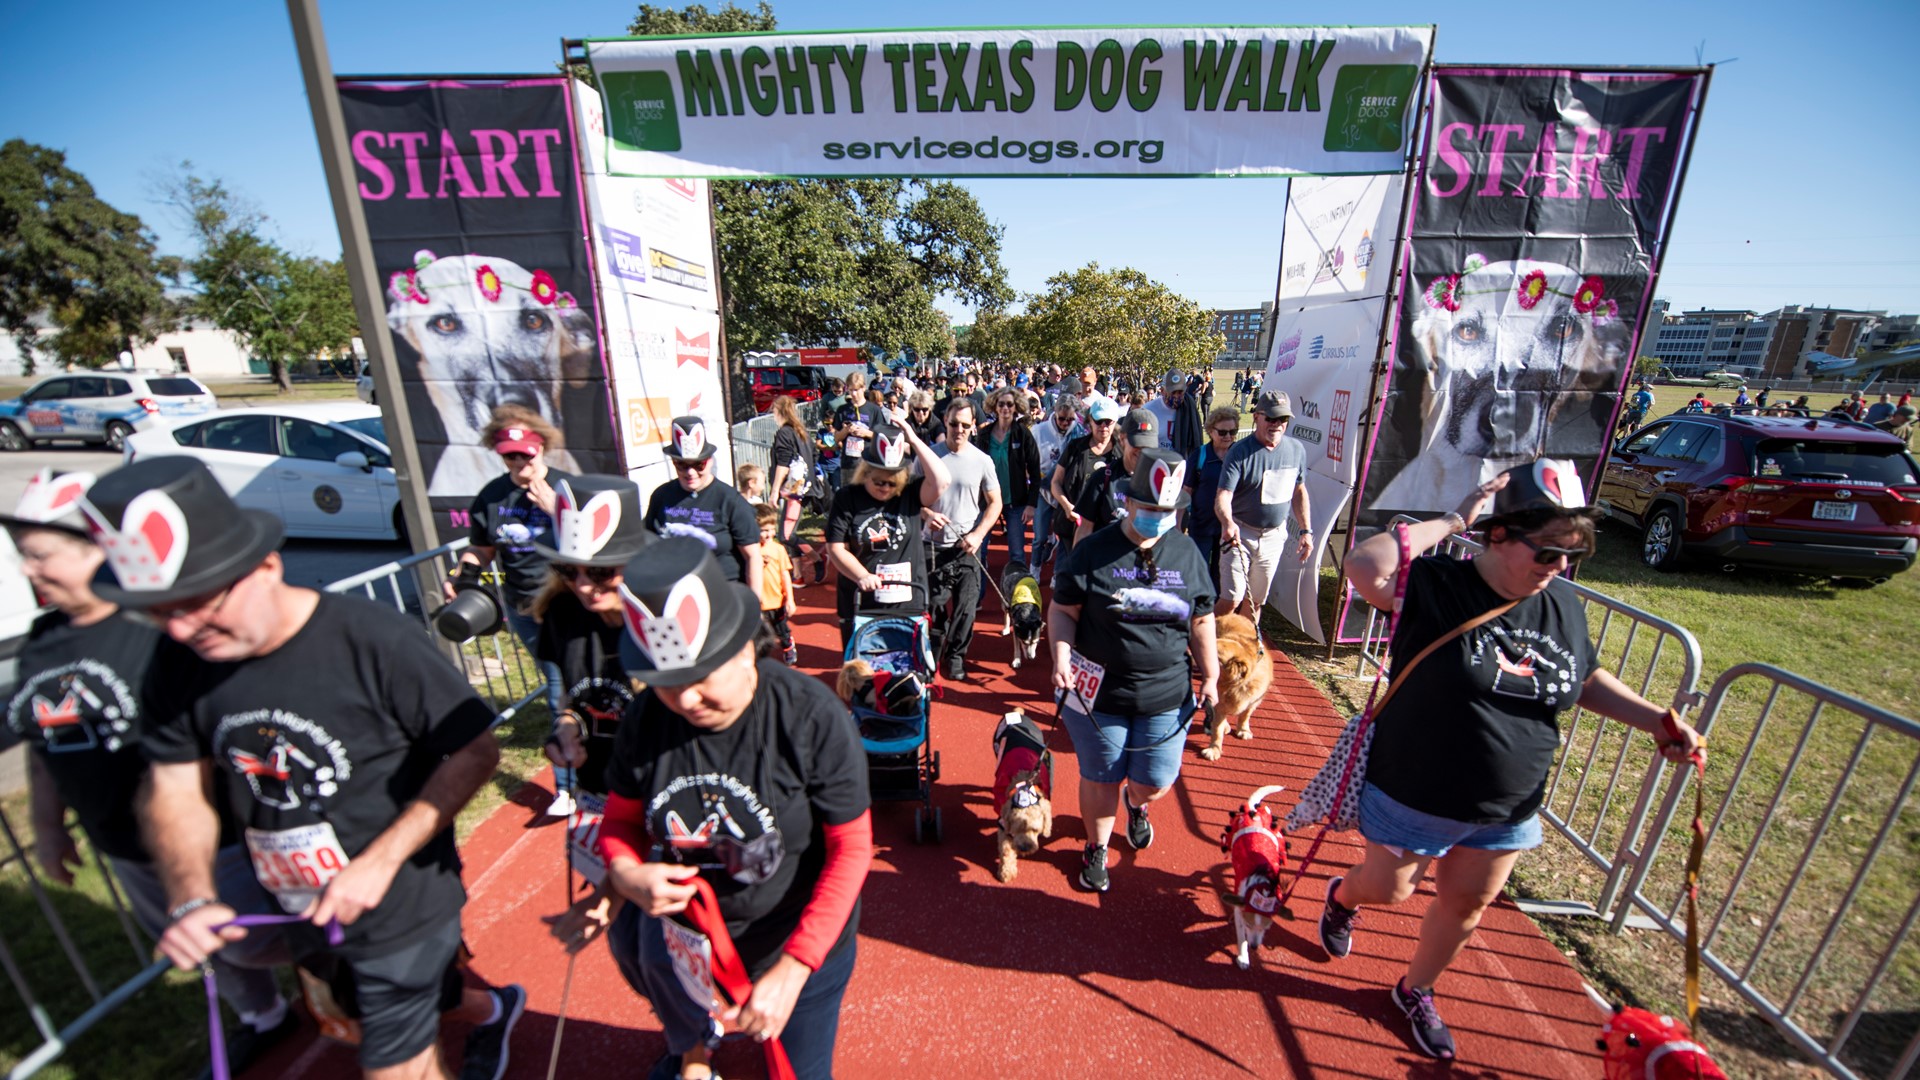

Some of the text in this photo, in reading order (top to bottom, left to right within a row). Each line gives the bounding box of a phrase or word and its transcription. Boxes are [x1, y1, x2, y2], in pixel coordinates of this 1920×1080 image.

[676, 38, 1336, 117] MIGHTY TEXAS DOG WALK
[633, 99, 666, 110] SERVICE
[1360, 96, 1398, 107] SERVICE
[634, 109, 663, 121] DOGS
[1357, 106, 1390, 118] DOGS
[823, 136, 1164, 163] servicedogs.org
[351, 128, 562, 201] START
[1430, 121, 1667, 200] START
[1321, 347, 1345, 359] CIRRUS
[1332, 393, 1349, 421] BOB
[1294, 426, 1320, 442] LAMAR
